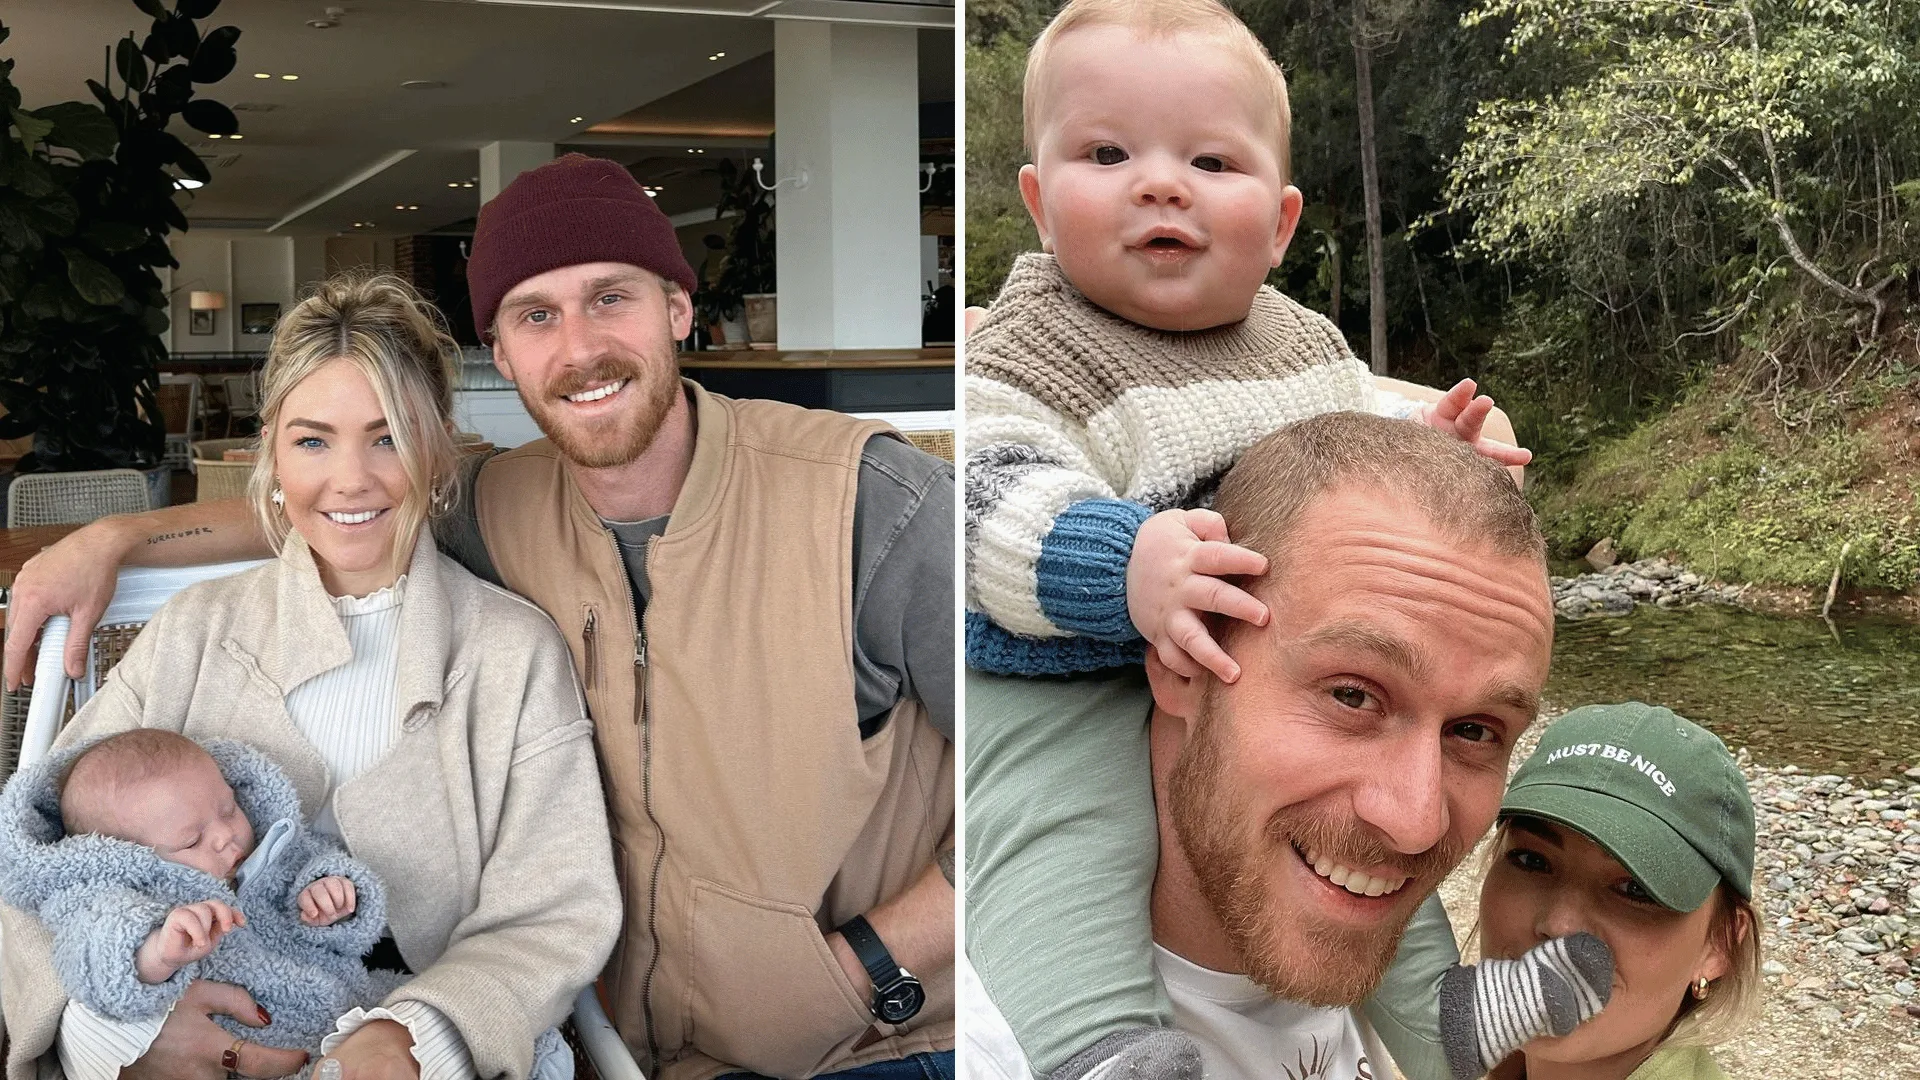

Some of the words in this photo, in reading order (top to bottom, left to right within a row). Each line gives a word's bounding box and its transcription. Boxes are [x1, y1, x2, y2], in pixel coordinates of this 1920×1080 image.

[1546, 743, 1601, 764] MUST
[1600, 744, 1632, 763] BE
[1630, 754, 1677, 797] NICE
